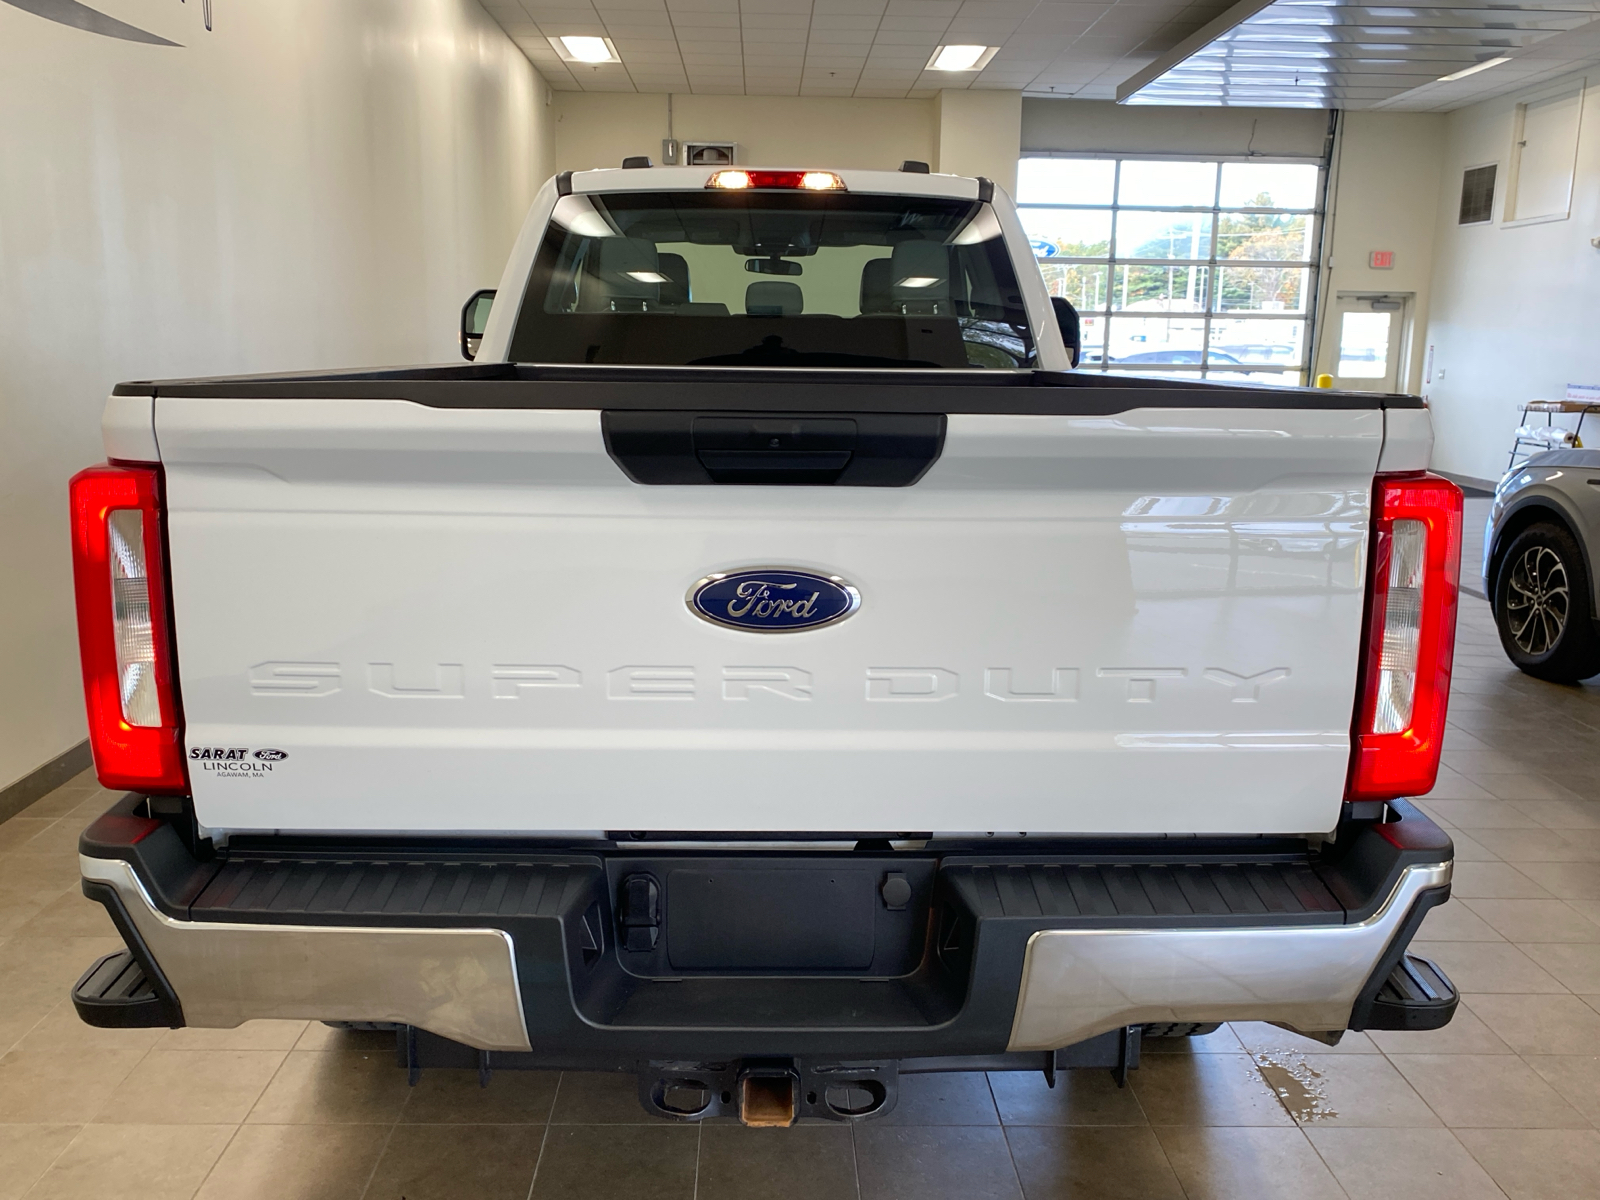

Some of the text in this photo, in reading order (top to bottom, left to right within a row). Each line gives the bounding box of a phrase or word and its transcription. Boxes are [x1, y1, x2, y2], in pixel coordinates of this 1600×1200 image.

[1373, 251, 1393, 266] EXIT
[727, 580, 820, 618] Ford
[249, 660, 1293, 704] SUPER DUTY
[190, 747, 248, 761] SARAT
[203, 762, 273, 772] LINCOLN
[216, 771, 251, 779] AGAWAM,
